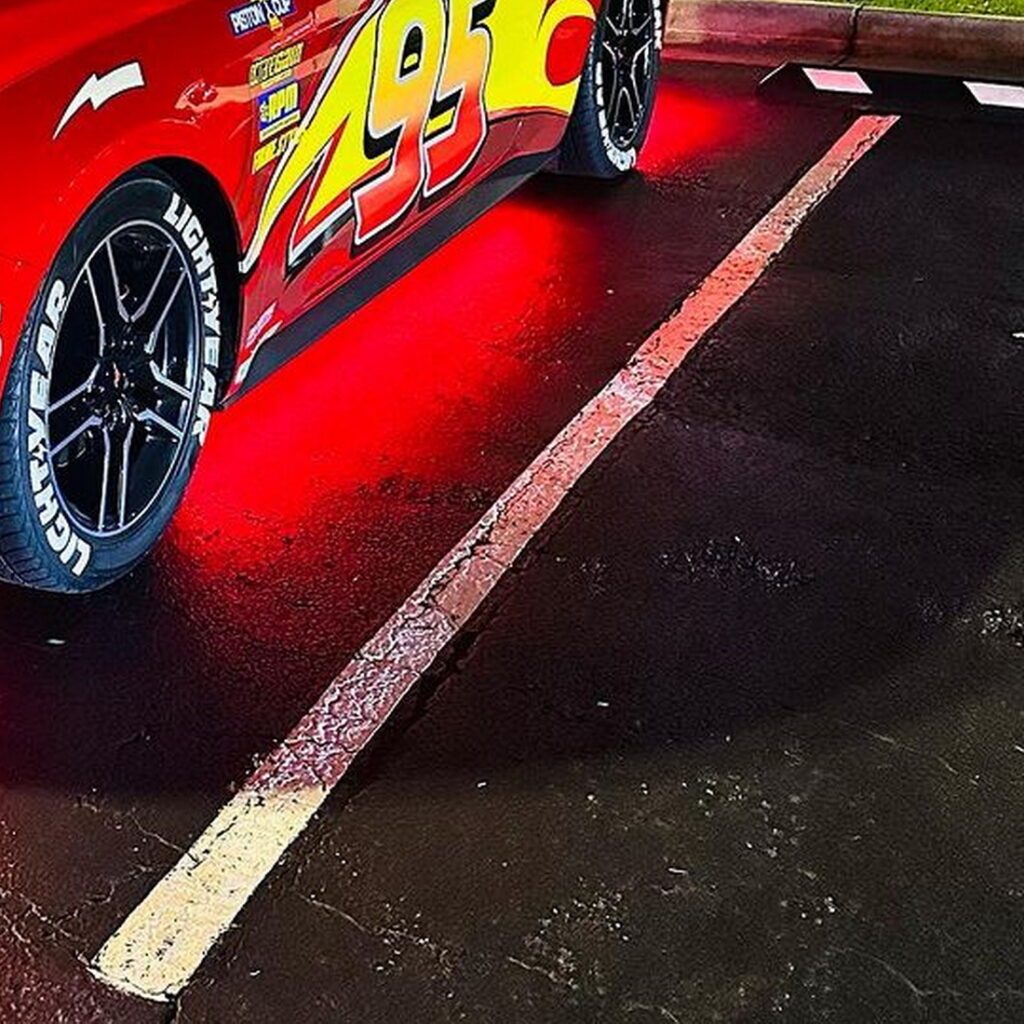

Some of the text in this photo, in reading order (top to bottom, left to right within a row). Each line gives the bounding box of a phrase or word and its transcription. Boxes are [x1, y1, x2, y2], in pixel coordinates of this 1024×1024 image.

[229, 2, 267, 34] PISTON
[27, 278, 95, 577] LIGHTYEAR
[162, 191, 223, 447] LIGHTYEAR
